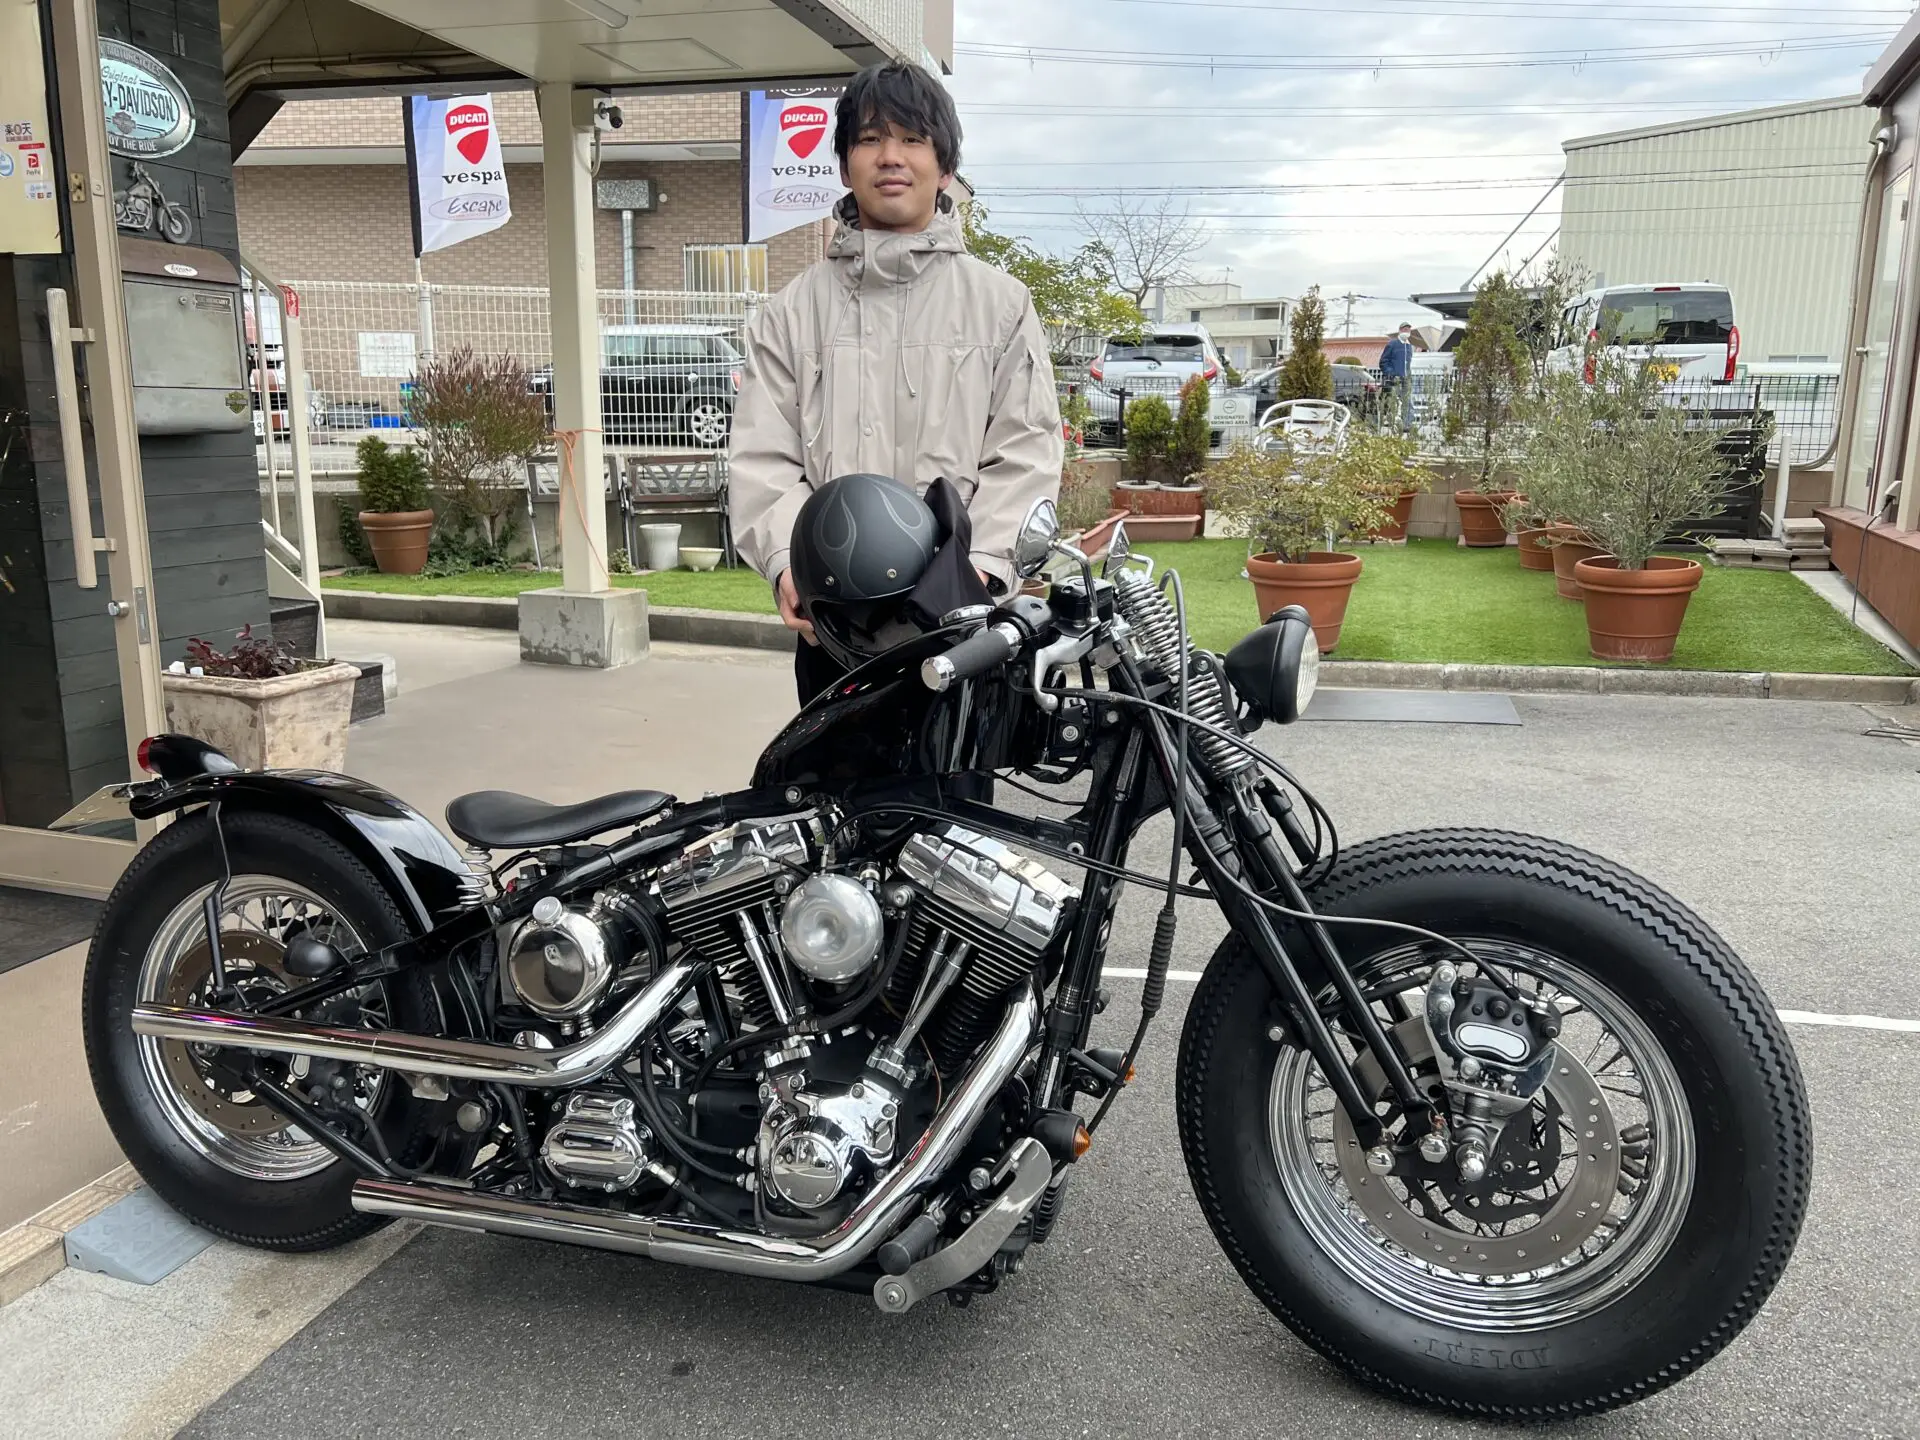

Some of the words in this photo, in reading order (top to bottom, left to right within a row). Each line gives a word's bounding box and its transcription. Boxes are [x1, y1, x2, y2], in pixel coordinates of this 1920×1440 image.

[102, 66, 139, 85] Original
[450, 112, 487, 125] DUCATI
[784, 113, 824, 124] DUCATI
[122, 138, 137, 150] THE
[138, 139, 157, 152] RIDE
[441, 169, 502, 185] vespa
[771, 164, 834, 177] vespa
[773, 188, 829, 207] Escape
[447, 197, 503, 216] Escape
